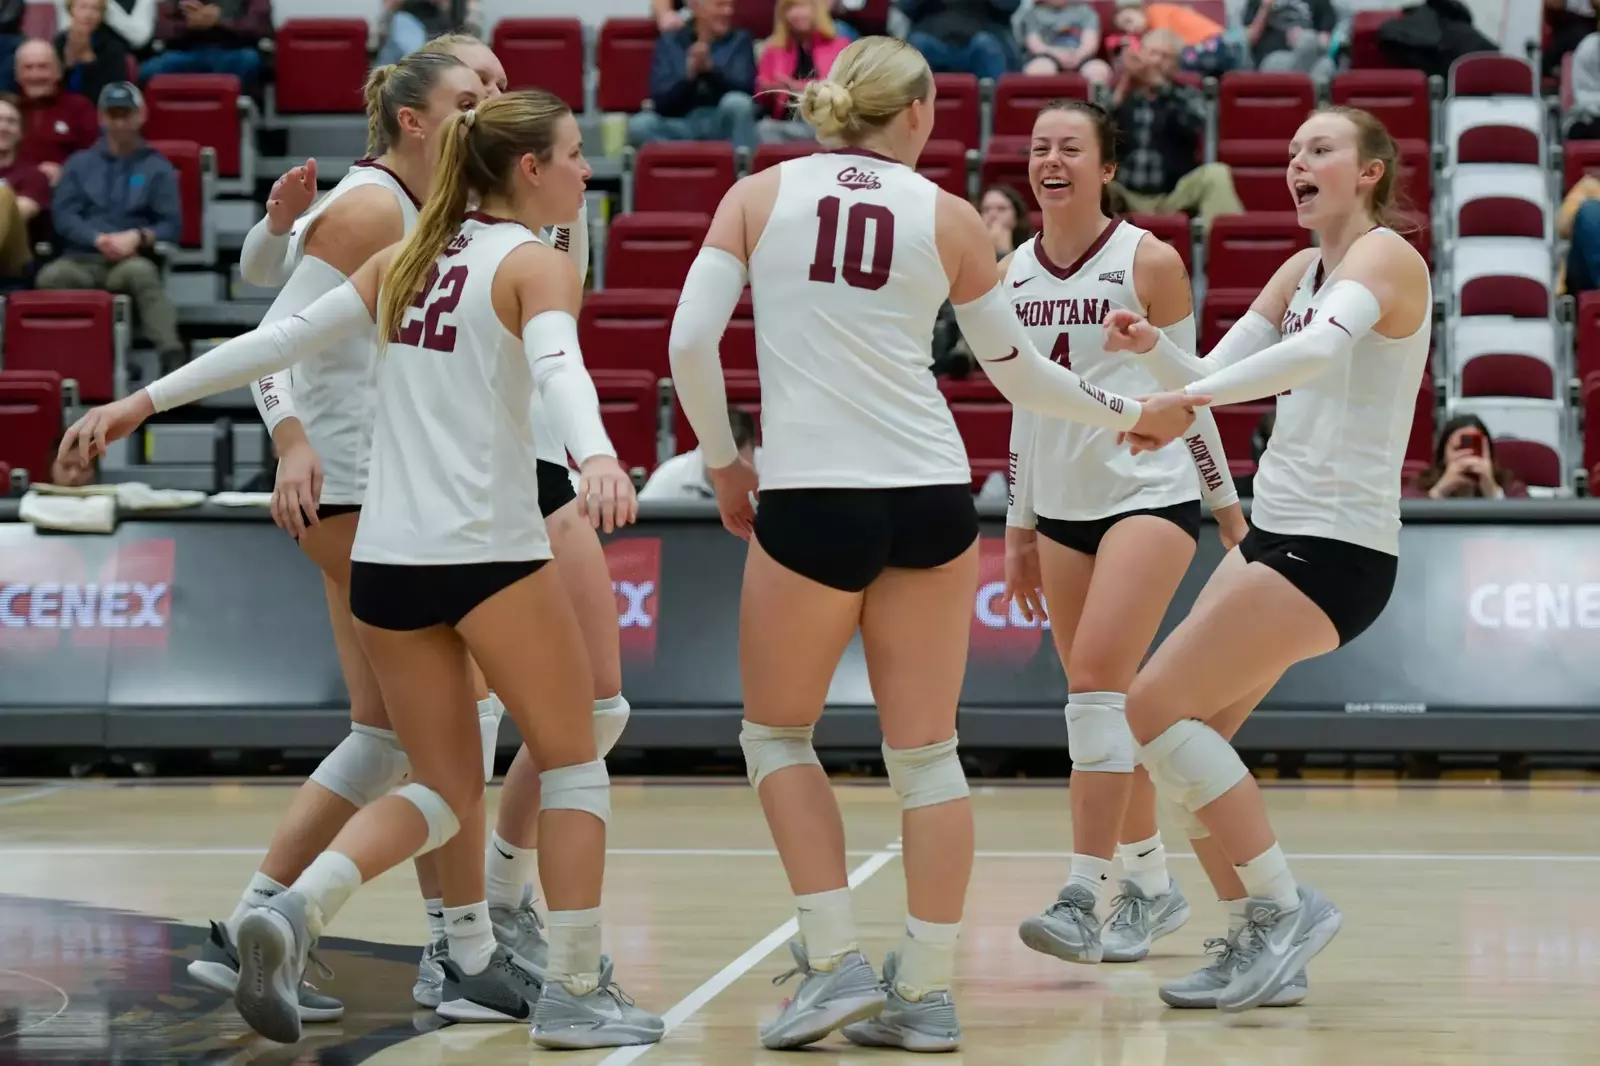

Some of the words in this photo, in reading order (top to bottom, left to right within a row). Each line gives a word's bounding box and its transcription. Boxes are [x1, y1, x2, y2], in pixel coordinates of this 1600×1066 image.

[837, 166, 881, 190] Griz
[554, 227, 570, 252] TANA
[809, 195, 895, 291] 10
[388, 262, 469, 353] 22
[1016, 298, 1110, 327] MONTANA
[1049, 332, 1071, 371] 4
[259, 376, 275, 396] WI
[1080, 379, 1106, 406] WITH
[264, 394, 280, 411] UP
[1110, 396, 1124, 414] UP
[1186, 434, 1224, 491] MONTANA
[0, 583, 166, 628] CENEX
[1469, 582, 1600, 628] CENE
